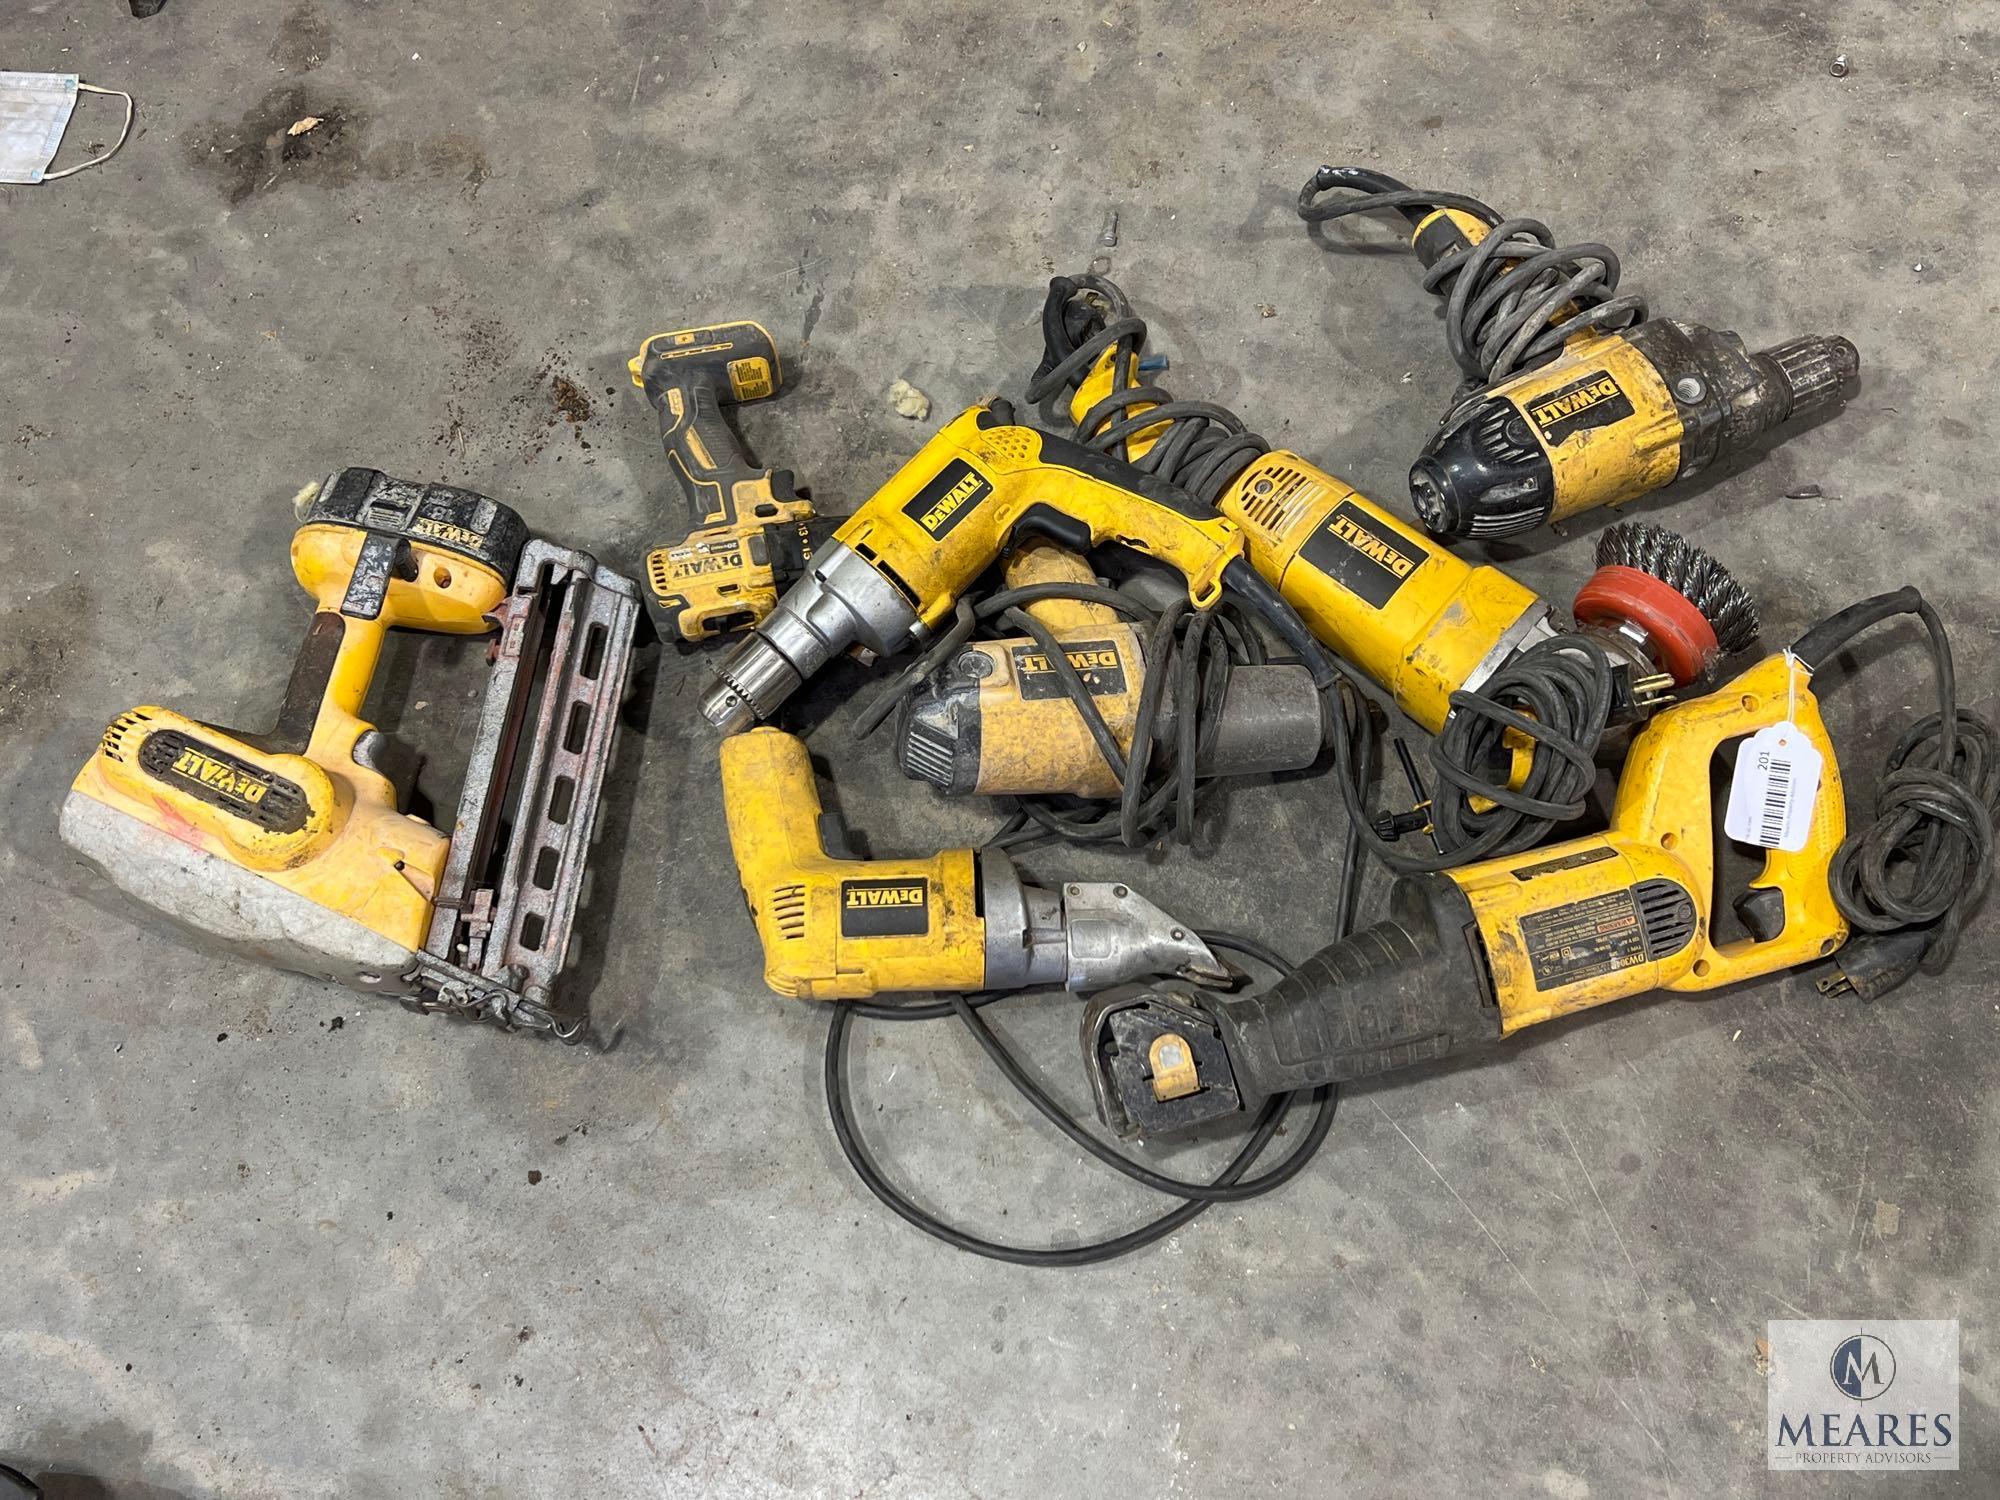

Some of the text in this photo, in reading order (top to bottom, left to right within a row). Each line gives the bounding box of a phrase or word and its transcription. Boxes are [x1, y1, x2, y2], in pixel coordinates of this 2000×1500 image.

[1534, 378, 1619, 425] DEWALT
[922, 471, 983, 530] DEWALT
[1330, 517, 1414, 578] DEWALT
[1023, 651, 1118, 672] DEWLT
[174, 751, 267, 803] DEWALT
[1758, 751, 1770, 771] 201
[847, 889, 923, 905] DEWALT
